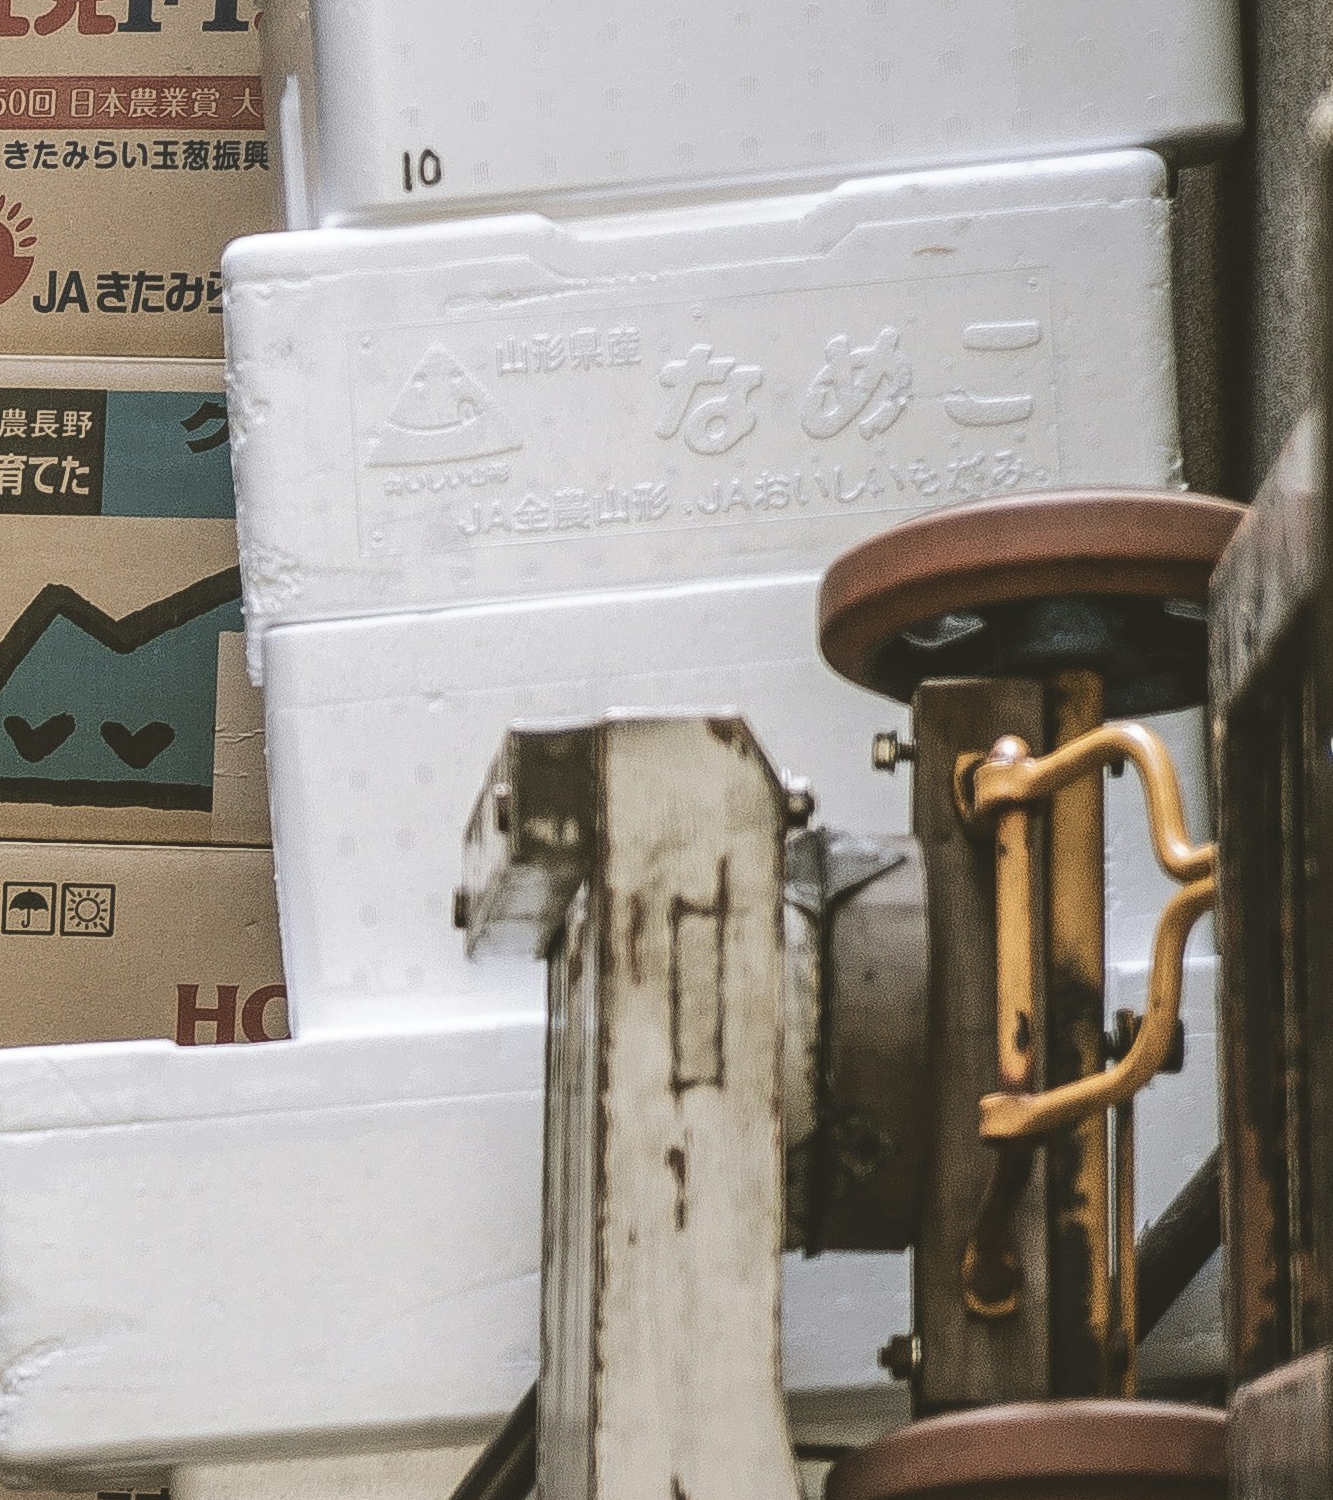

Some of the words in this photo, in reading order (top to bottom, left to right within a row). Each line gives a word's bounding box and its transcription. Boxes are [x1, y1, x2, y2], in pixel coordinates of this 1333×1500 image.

[70, 87, 222, 120] 日本農業賞
[3, 140, 270, 172] きたみらい玉葱振興
[400, 149, 442, 191] 10
[495, 326, 642, 377] 山形県産
[655, 318, 1043, 456] なめこ
